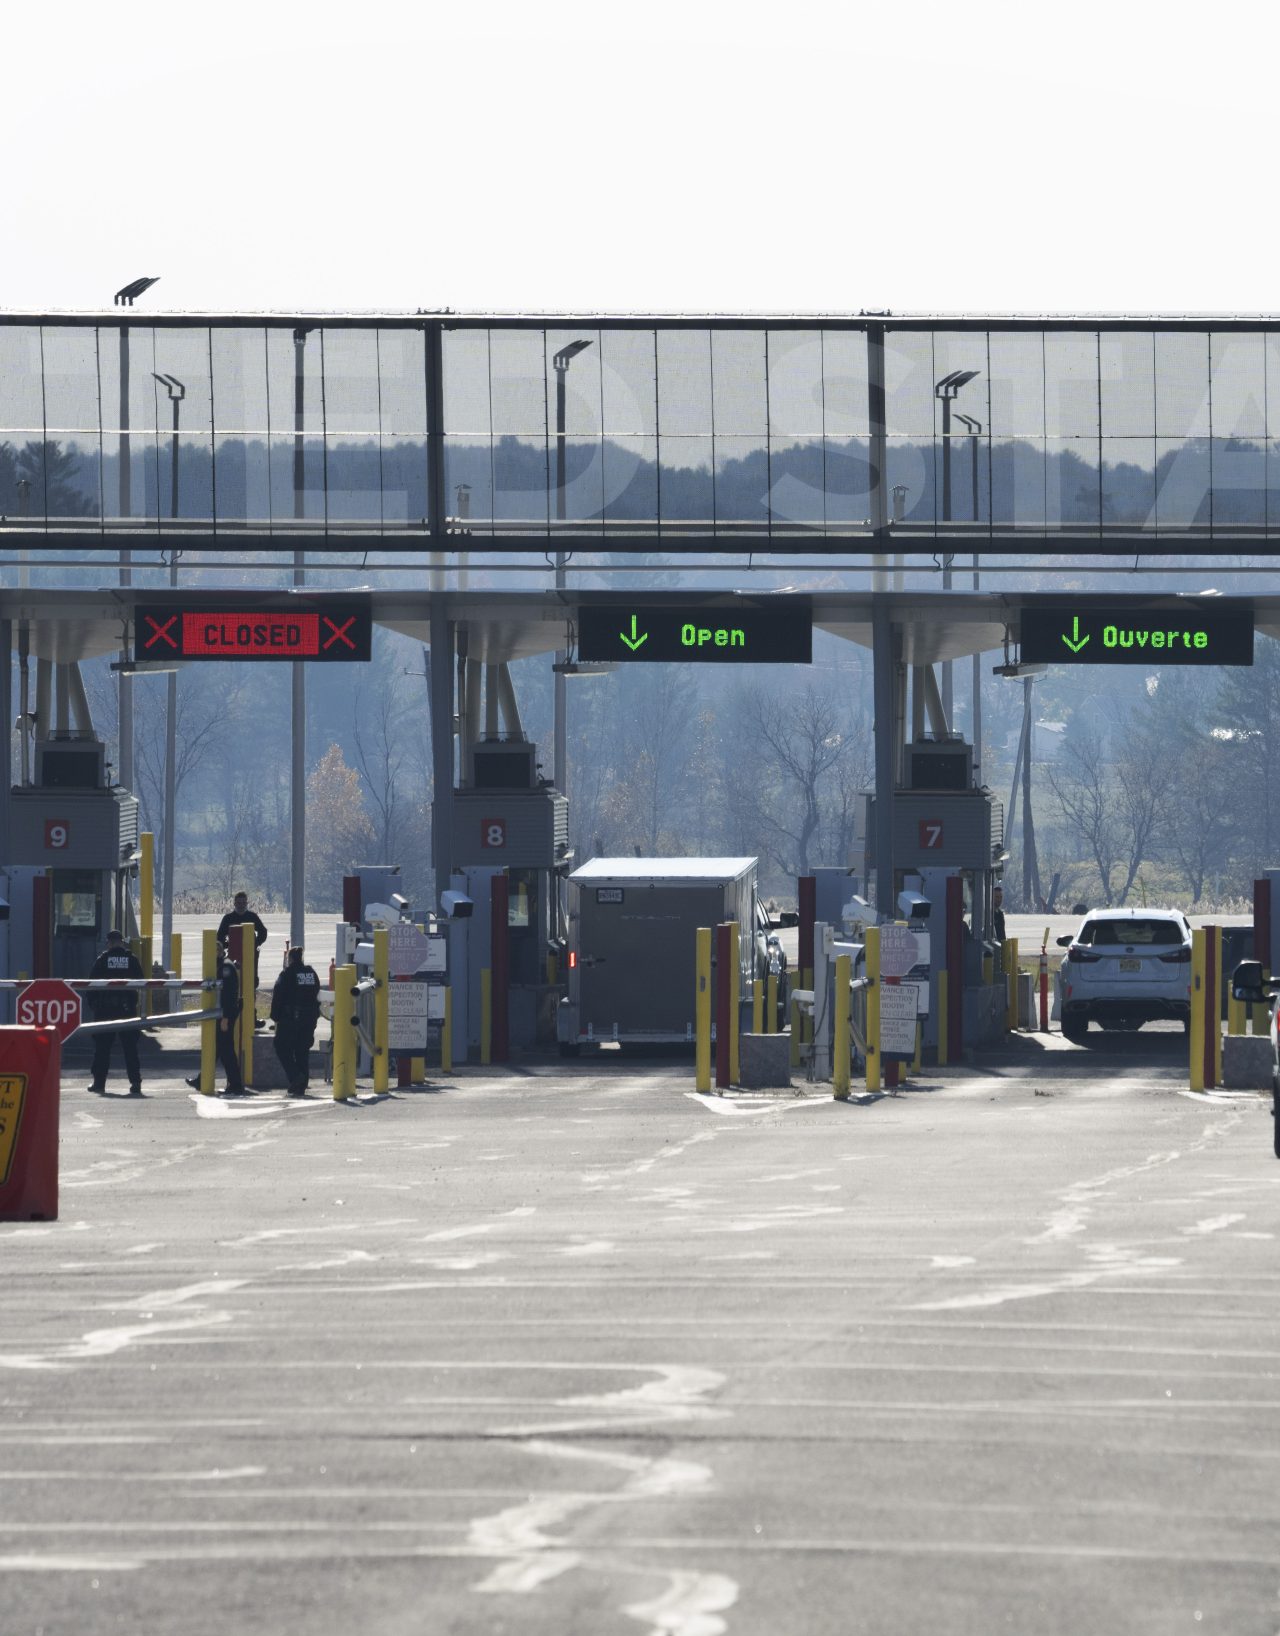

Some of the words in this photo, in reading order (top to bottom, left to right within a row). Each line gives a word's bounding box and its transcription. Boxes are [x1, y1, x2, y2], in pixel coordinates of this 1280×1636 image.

[204, 624, 301, 646] CLOSED
[681, 624, 745, 646] Open
[1103, 625, 1208, 648] Ouverte
[51, 826, 66, 847] 9
[488, 825, 503, 846] 8
[926, 826, 941, 847] 7
[390, 937, 417, 947] HERE
[391, 927, 417, 937] STOP
[881, 928, 907, 938] STOP
[881, 938, 907, 948] HERE
[21, 1000, 77, 1024] STOP
